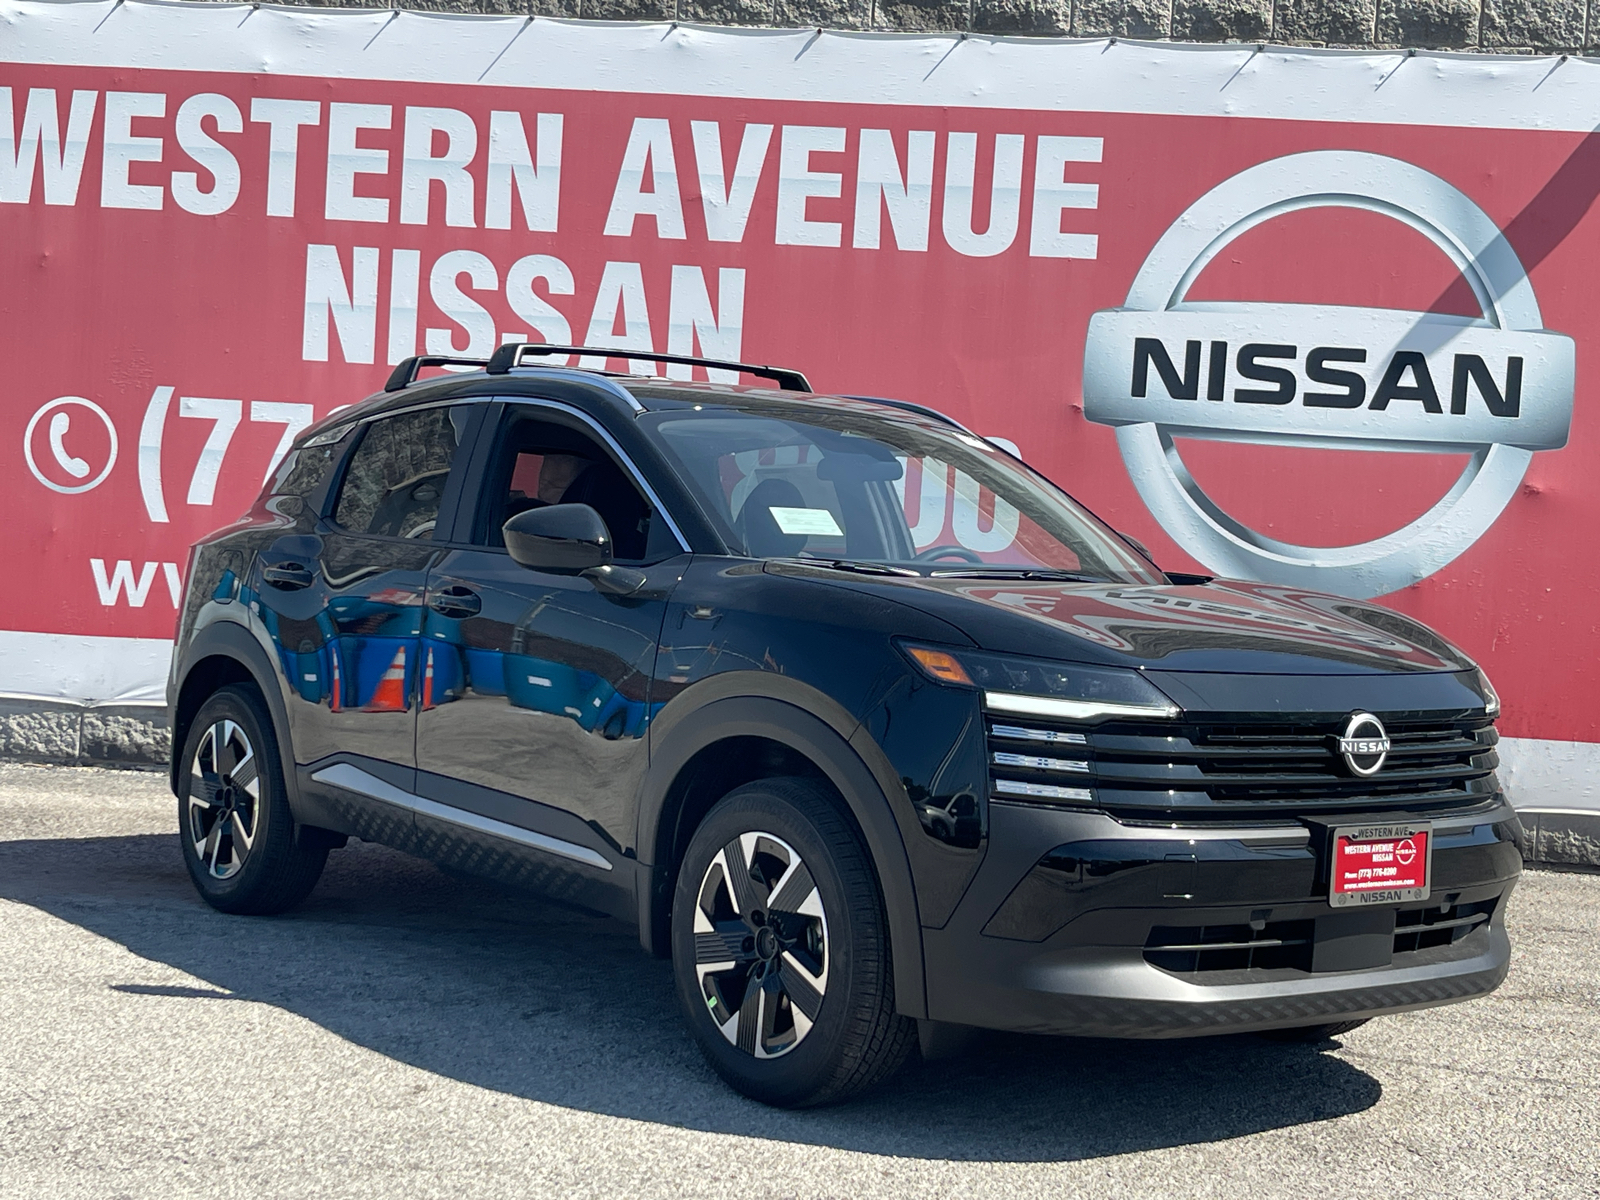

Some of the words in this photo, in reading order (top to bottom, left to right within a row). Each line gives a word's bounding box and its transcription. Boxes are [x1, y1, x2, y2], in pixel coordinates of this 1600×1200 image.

[0, 86, 564, 233] WESTERN
[603, 117, 1104, 260] AVENUE
[302, 243, 747, 386] NISSAN
[1131, 337, 1524, 419] NISSAN
[138, 385, 353, 523] (77
[1341, 740, 1390, 752] NISSAN
[1358, 827, 1393, 838] WESTERN
[1394, 826, 1409, 837] AVE
[1344, 844, 1371, 855] WESTERN
[1372, 843, 1394, 853] AVENUE
[1372, 853, 1393, 862] NISSAN
[1360, 890, 1402, 903] NISSAN
